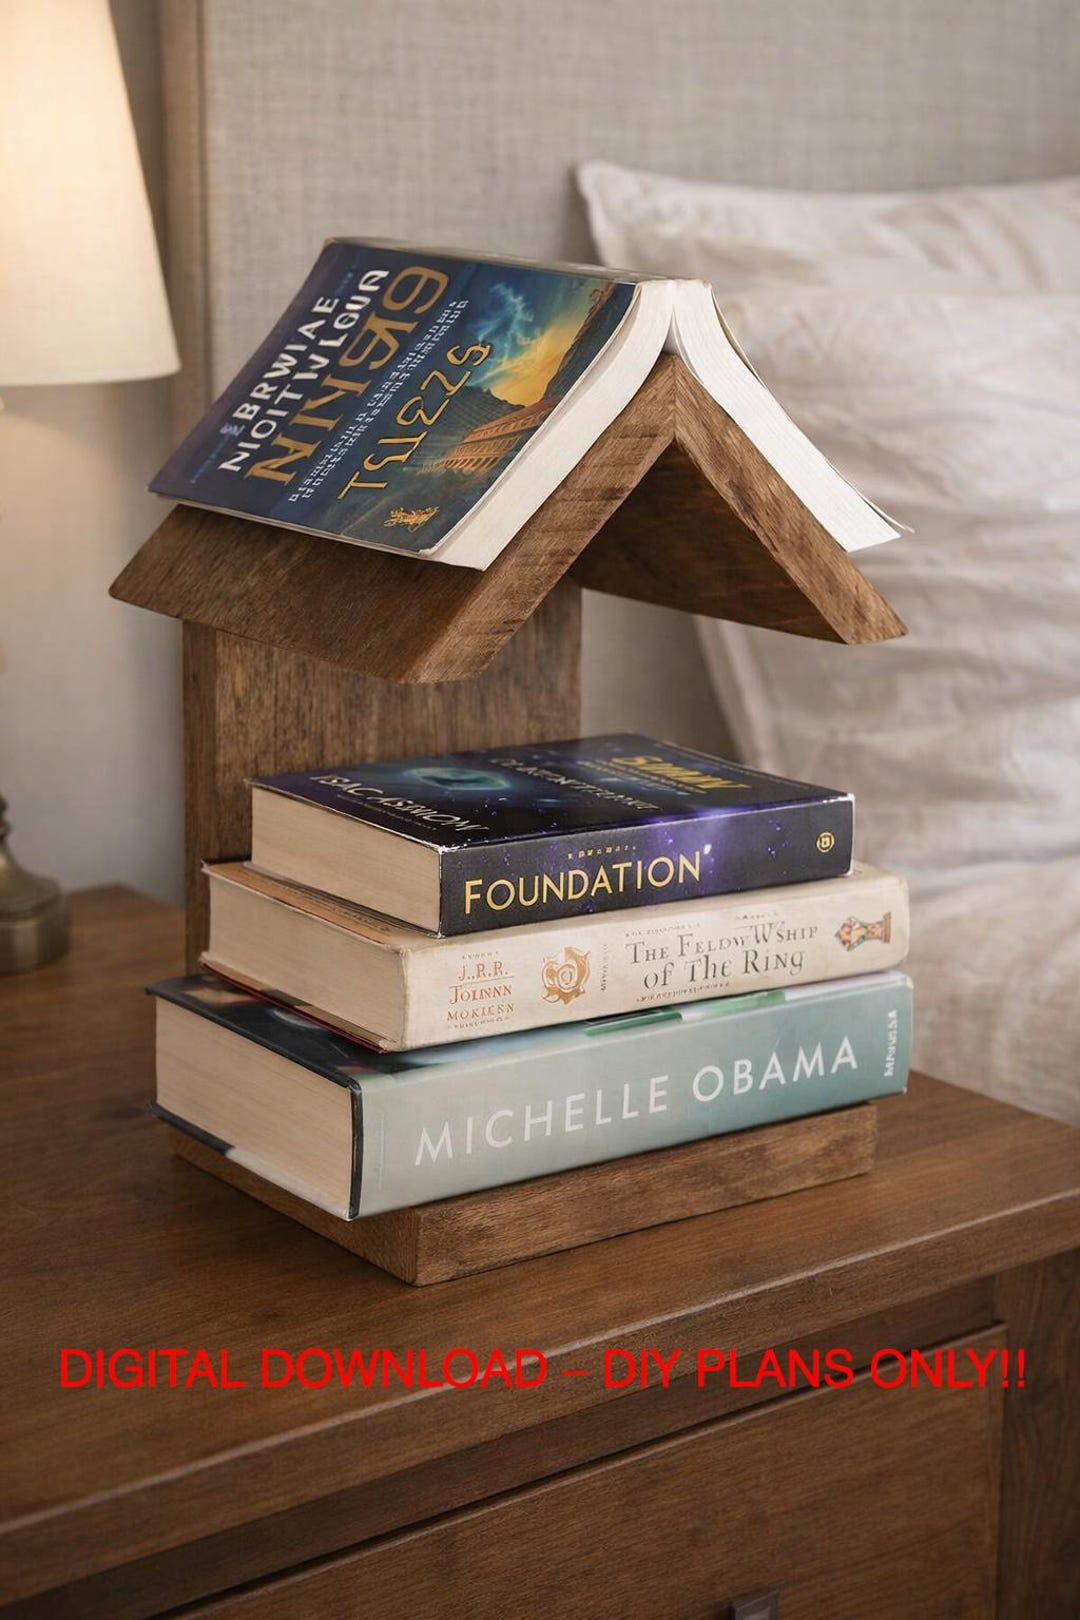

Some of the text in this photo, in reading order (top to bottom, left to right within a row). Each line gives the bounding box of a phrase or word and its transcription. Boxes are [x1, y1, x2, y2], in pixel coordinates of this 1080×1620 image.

[464, 851, 701, 915] FOUNDATION
[414, 1074, 670, 1167] MICHELLE
[691, 1035, 859, 1102] OBAMA
